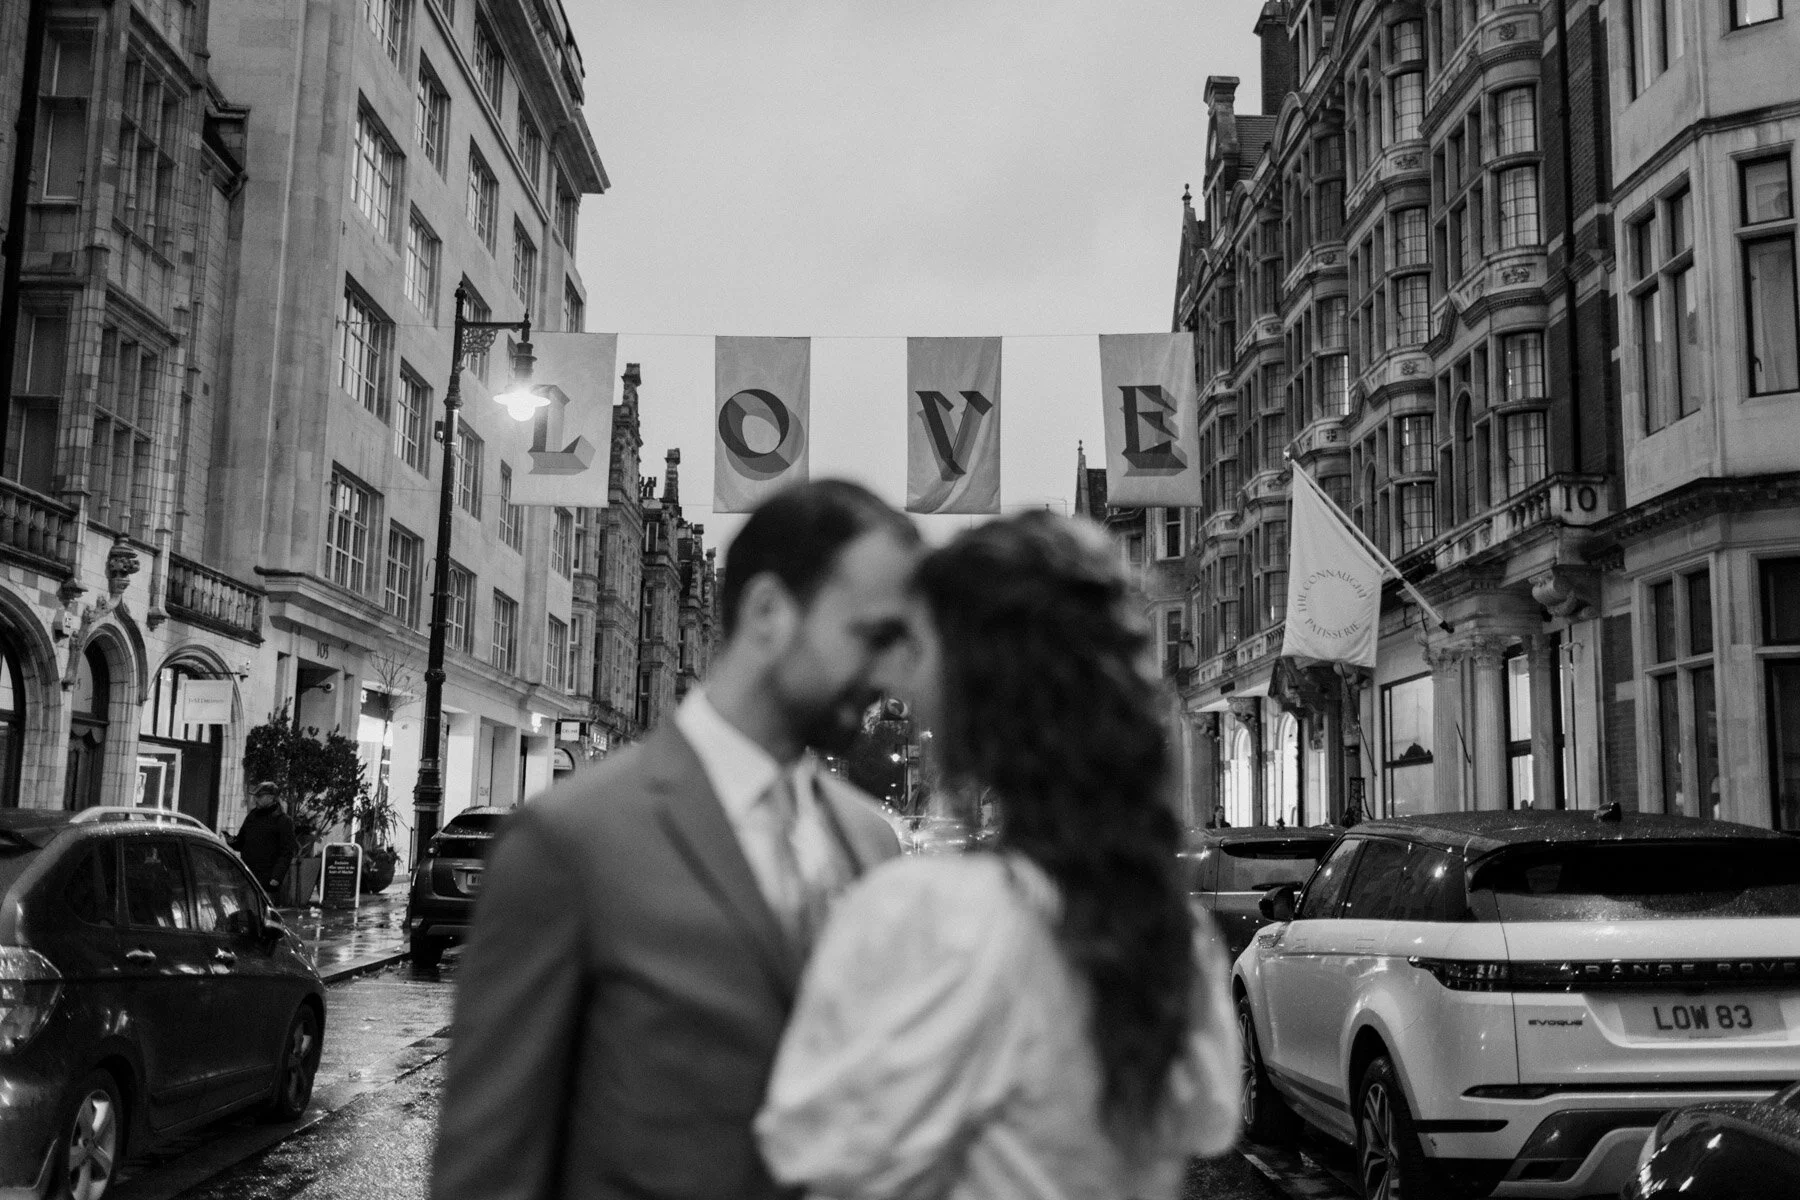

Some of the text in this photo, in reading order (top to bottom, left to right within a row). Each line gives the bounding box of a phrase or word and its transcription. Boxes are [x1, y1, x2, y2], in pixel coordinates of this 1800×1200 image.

[1564, 485, 1597, 512] 10
[1303, 569, 1367, 599] CONNAUGHT
[1305, 618, 1360, 638] PATISSERIE
[1585, 963, 1695, 977] RANGE
[1528, 1018, 1583, 1028] EVOQUE
[1653, 1004, 1753, 1031] LOW 83
